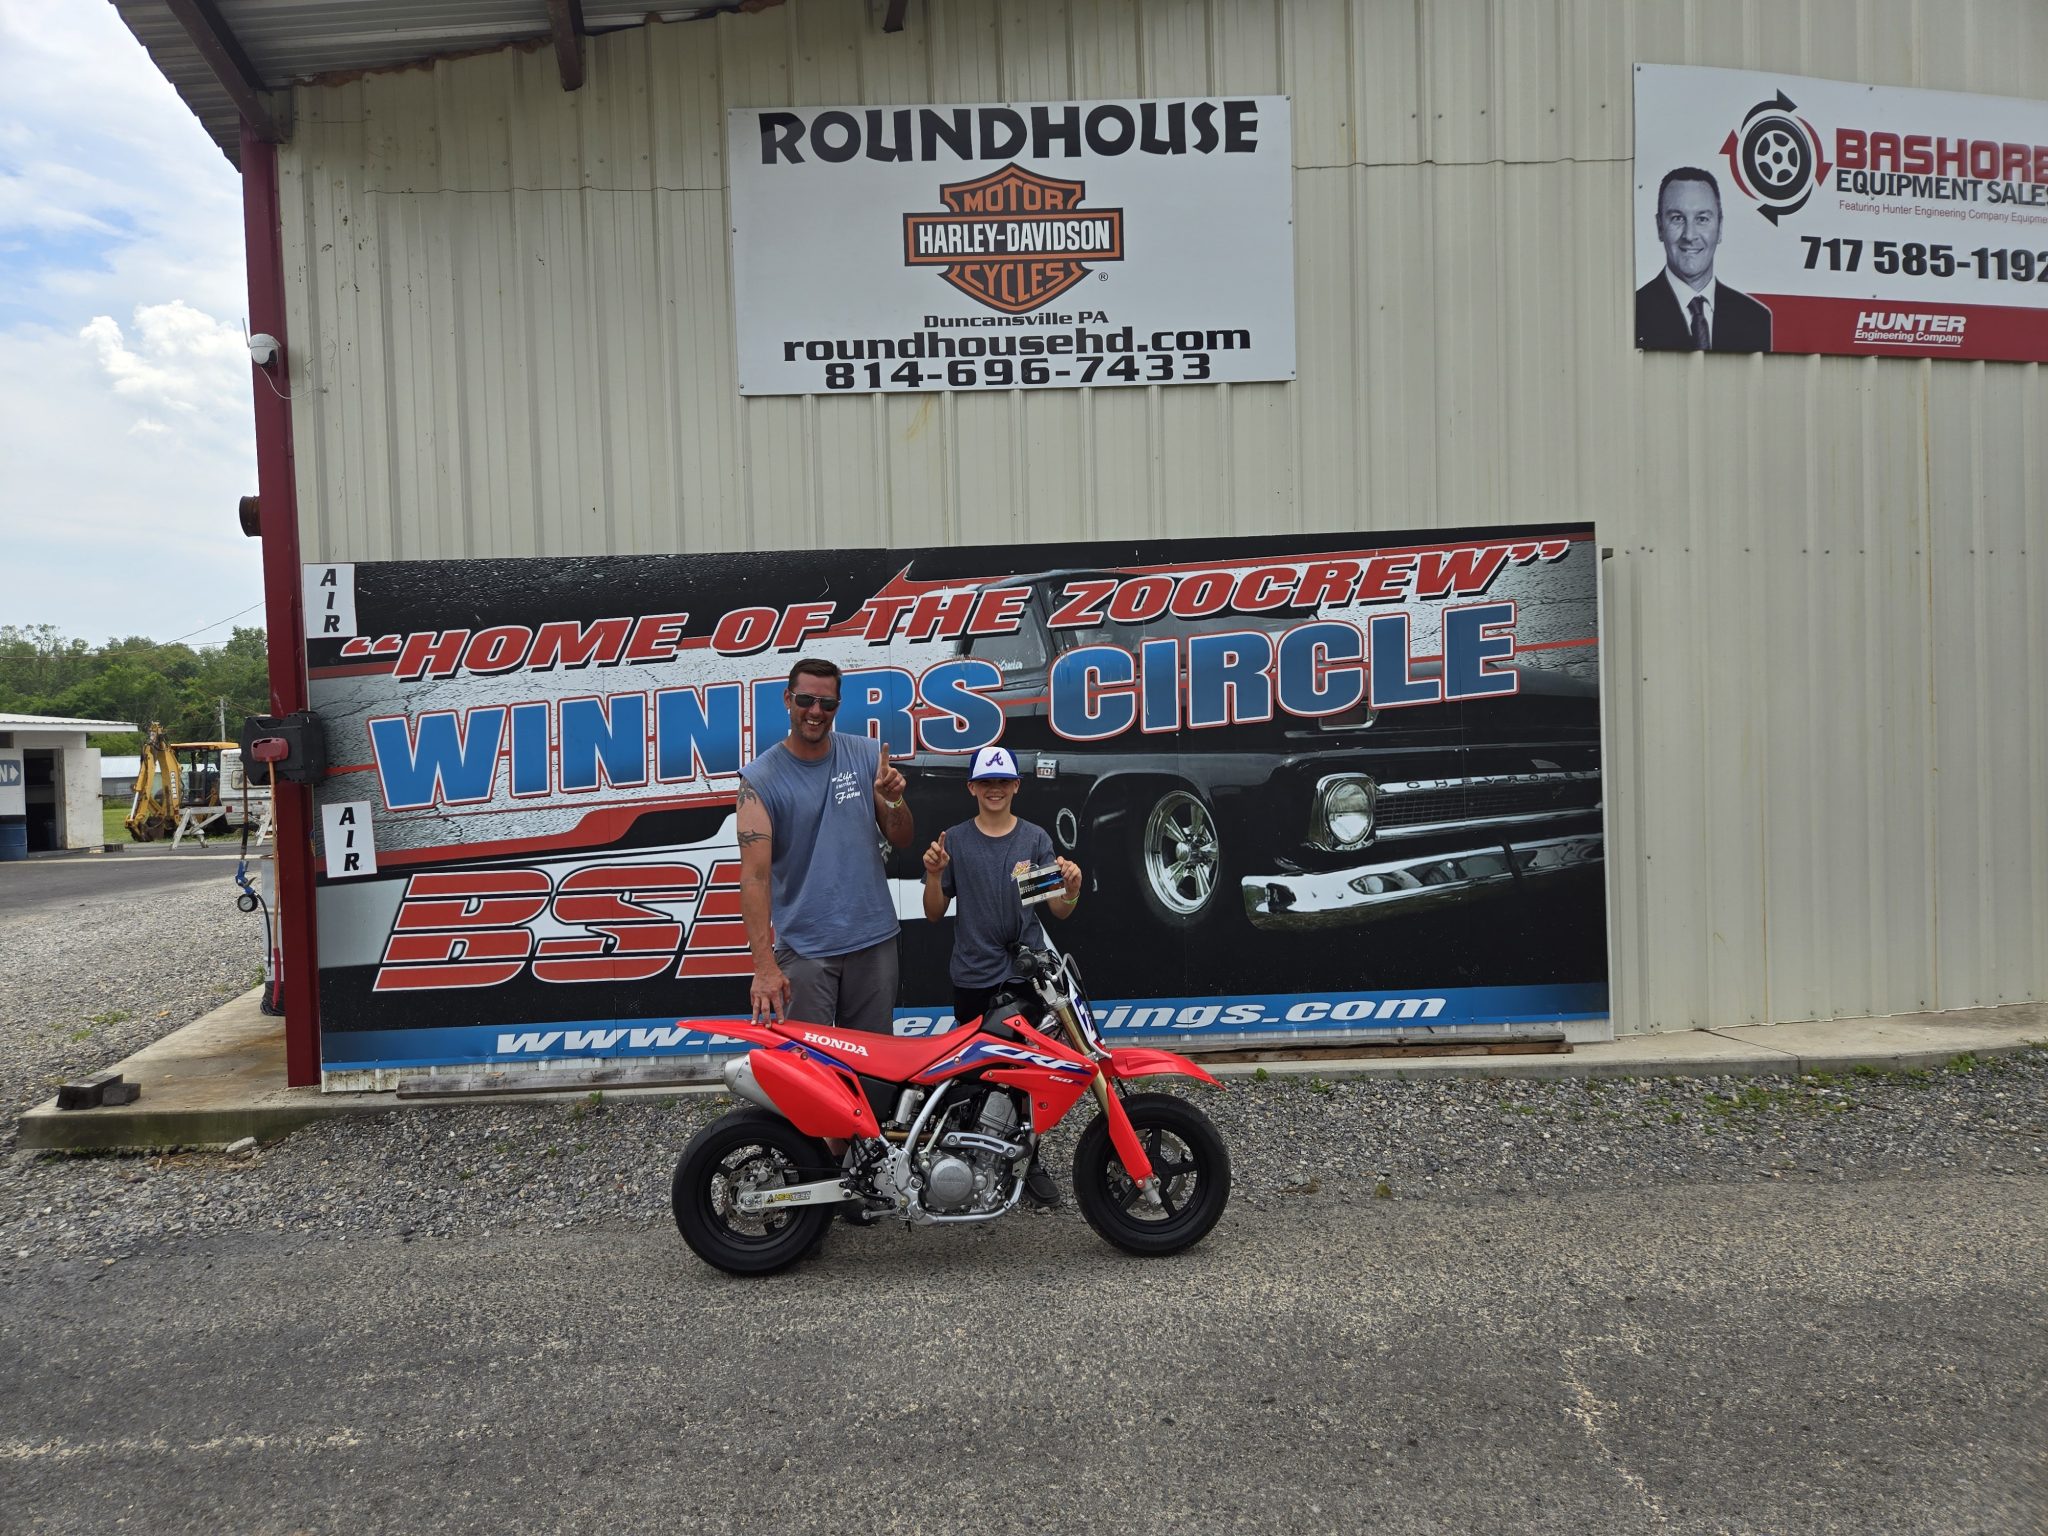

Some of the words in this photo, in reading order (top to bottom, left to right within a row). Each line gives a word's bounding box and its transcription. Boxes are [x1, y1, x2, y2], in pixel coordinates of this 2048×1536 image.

[758, 100, 1259, 165] ROUNDHOUSE
[1835, 128, 2048, 184] BASHORE
[963, 176, 1064, 213] MOTOR
[1836, 169, 1983, 202] EQUIPMENT
[1987, 181, 2048, 208] SALE
[1839, 200, 1880, 215] Featuring
[1883, 203, 1913, 215] Hunter
[1915, 205, 1966, 220] Engineering
[1968, 209, 2009, 223] Company
[919, 219, 1110, 255] HARLEY-DAVIDSON
[1800, 236, 1863, 272] 717
[964, 261, 1065, 304] CYCLES
[924, 312, 1073, 328] Duncansville
[1078, 310, 1109, 324] PA
[1854, 329, 1914, 343] Engineering
[1915, 331, 1964, 345] Company
[1856, 311, 1967, 333] HUNTER
[783, 326, 1251, 363] roundhousehd.com
[824, 353, 1211, 390] 814-696-7433
[320, 568, 340, 633] AIR
[709, 600, 835, 658] OF
[861, 586, 1034, 643] THE
[1048, 600, 1520, 741] CIRCLE
[339, 806, 360, 872] AIR
[803, 1031, 869, 1057] HONDA
